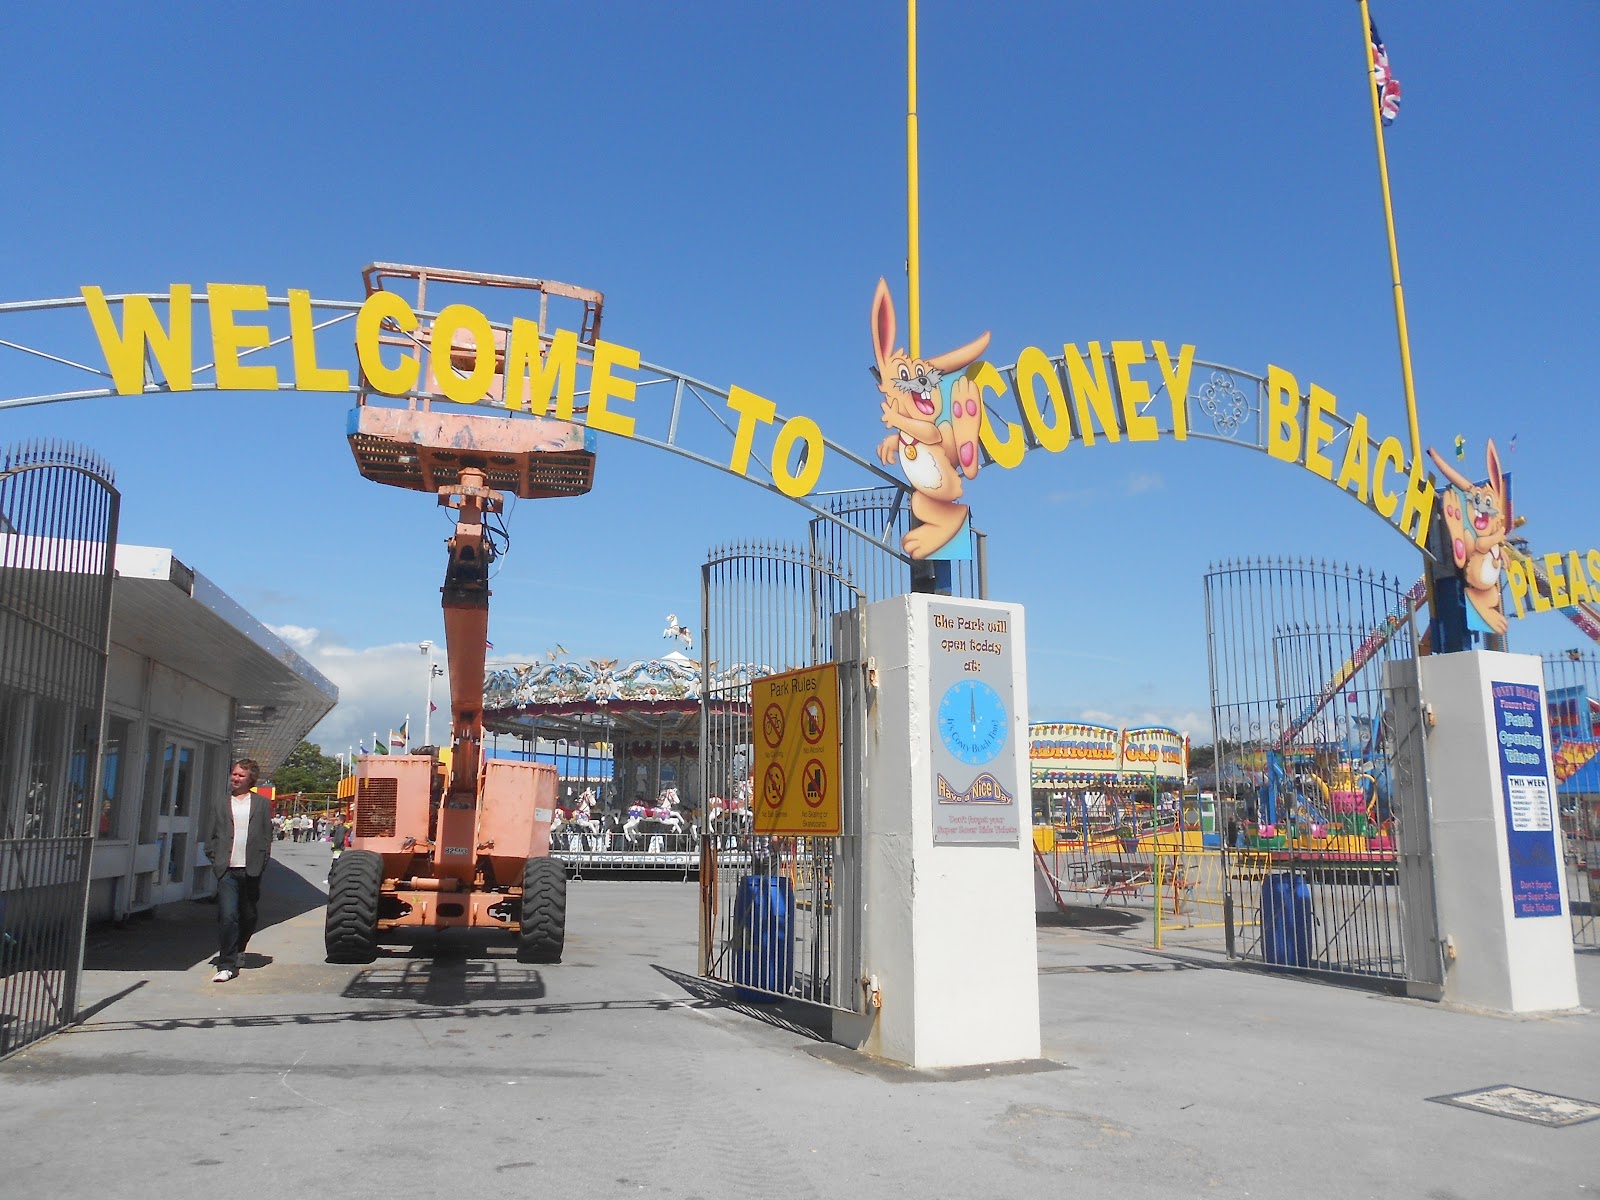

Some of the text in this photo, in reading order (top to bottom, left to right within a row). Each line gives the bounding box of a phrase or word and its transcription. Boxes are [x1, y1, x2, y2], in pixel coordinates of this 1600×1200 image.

[80, 283, 825, 497] WELCOME TO
[964, 340, 1435, 549] CONEY BEACH
[933, 613, 1008, 633] The Park will
[941, 638, 1002, 656] open today
[963, 659, 981, 672] at:
[770, 677, 817, 697] Park Rules
[1504, 711, 1534, 727] Park
[1499, 730, 1542, 750] Opening
[1029, 740, 1117, 761] ADITIONAL
[1126, 744, 1160, 761] OLD
[1505, 749, 1540, 764] Times
[938, 777, 1012, 804] Have a Nice Day
[1509, 778, 1546, 787] THIS WEEK
